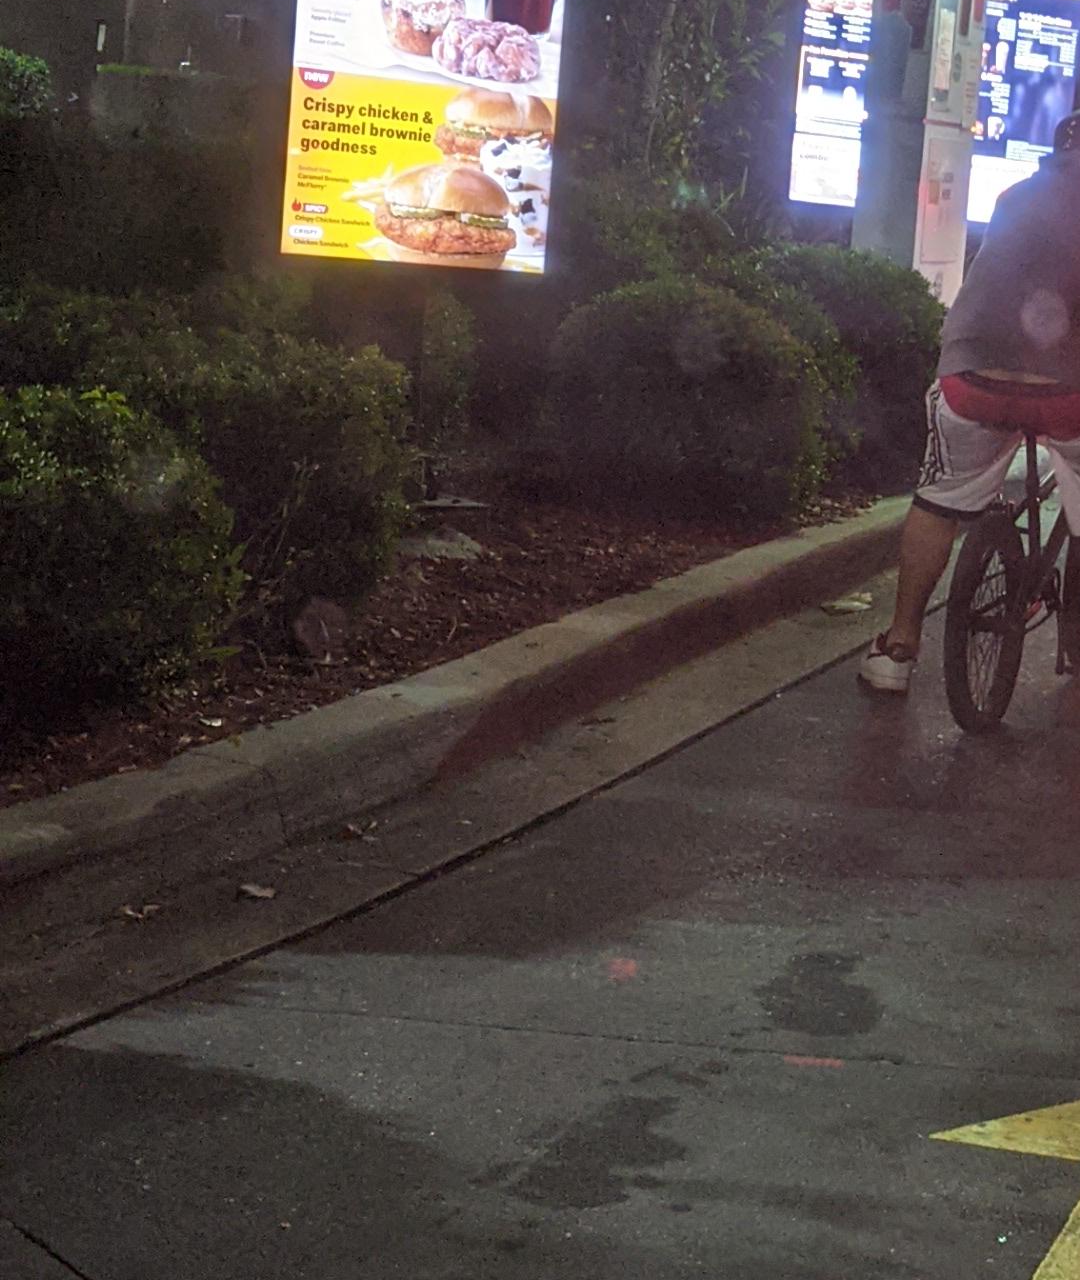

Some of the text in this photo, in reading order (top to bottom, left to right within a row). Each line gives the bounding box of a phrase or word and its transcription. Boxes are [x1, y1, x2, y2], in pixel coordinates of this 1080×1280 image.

[303, 96, 434, 124] Crispy chicken &
[302, 118, 432, 142] caramel brownie
[300, 137, 378, 156] goodness
